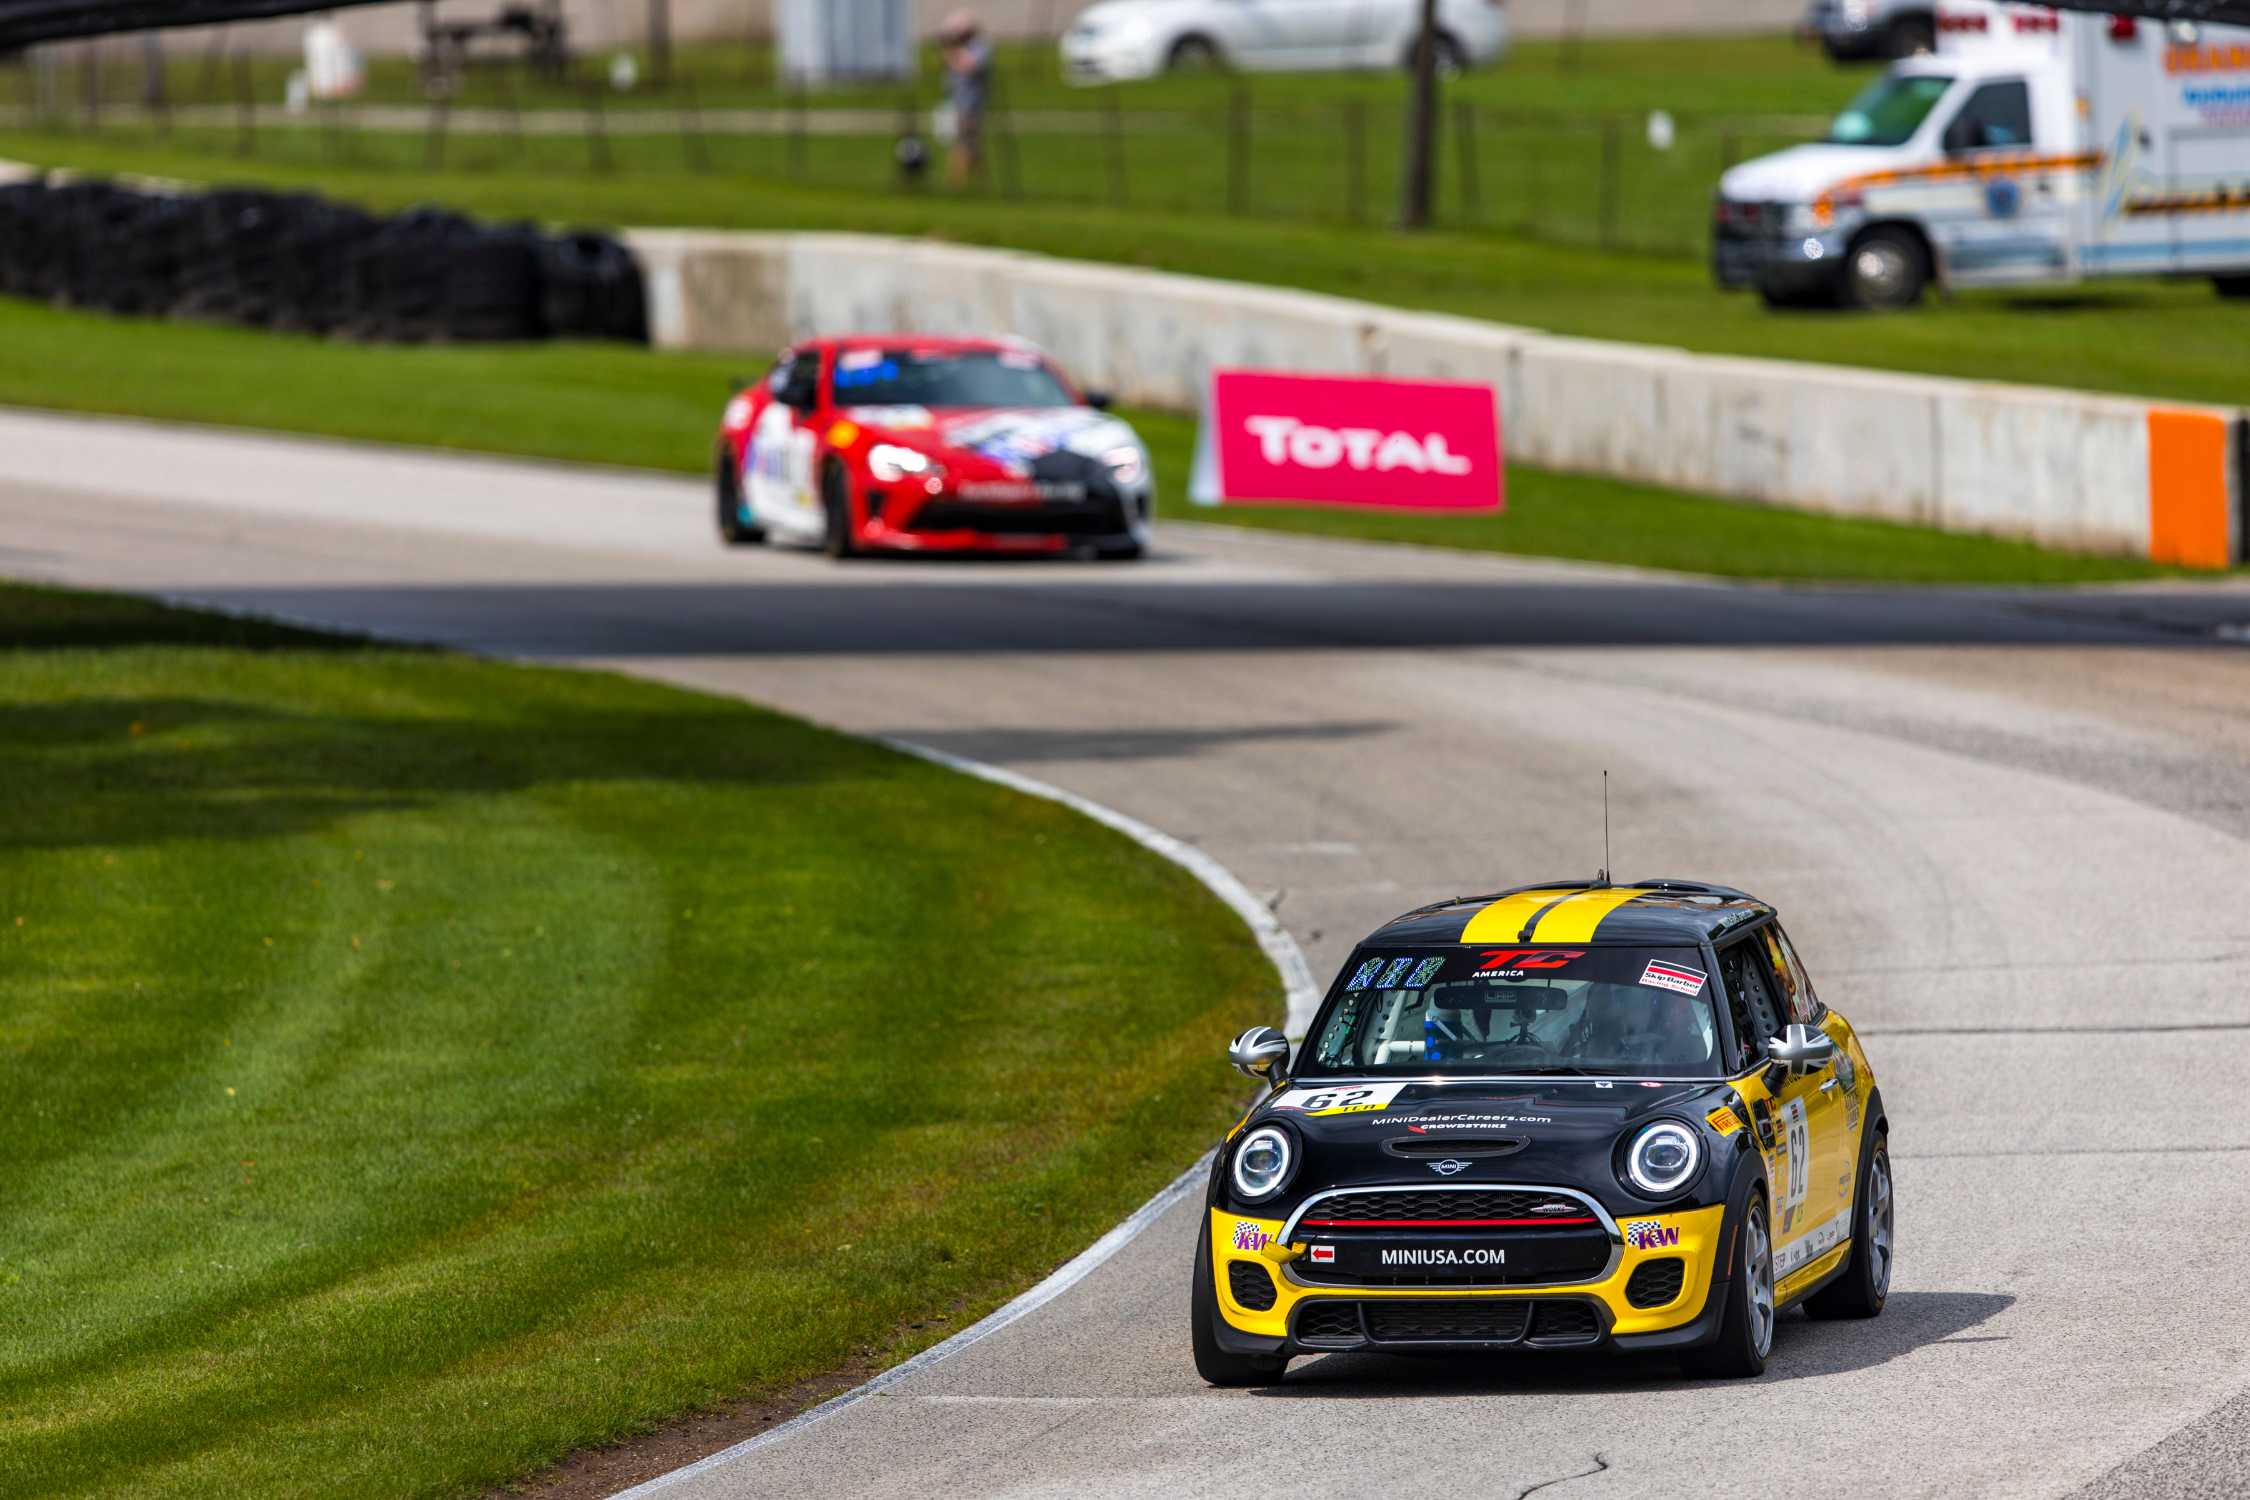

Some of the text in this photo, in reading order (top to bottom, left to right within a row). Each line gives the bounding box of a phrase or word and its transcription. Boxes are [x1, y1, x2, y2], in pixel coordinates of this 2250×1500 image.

[1245, 415, 1472, 476] TOTAL
[1480, 950, 1586, 969] TC
[1472, 970, 1524, 978] AMERICA
[1301, 1090, 1374, 1109] 62
[1372, 1114, 1551, 1126] MINIDealerCareers.com
[1790, 1125, 1805, 1198] 62
[1237, 1231, 1274, 1251] KW
[1639, 1226, 1680, 1250] KW
[1382, 1249, 1505, 1265] MINIUSA.COM
